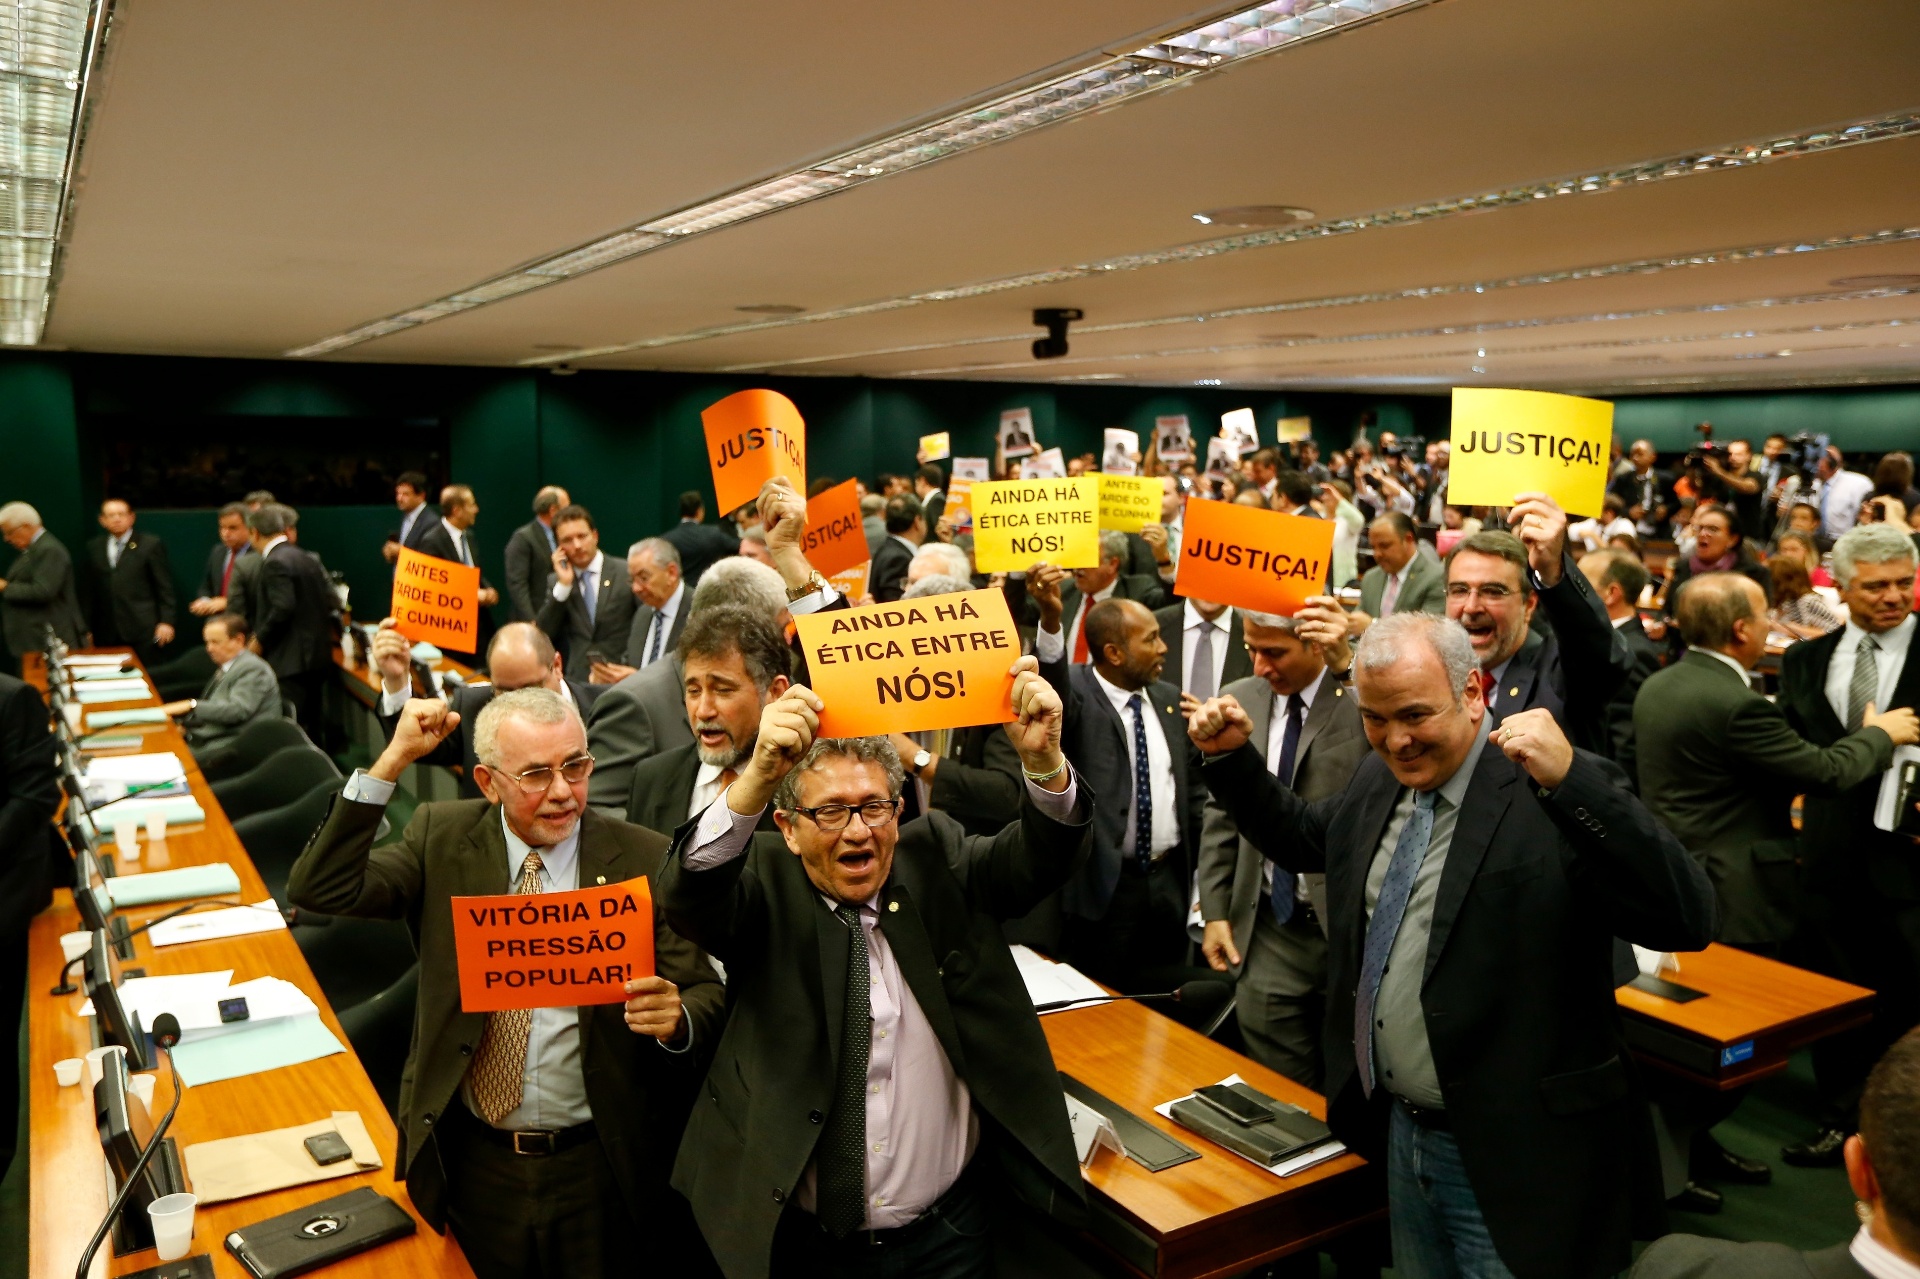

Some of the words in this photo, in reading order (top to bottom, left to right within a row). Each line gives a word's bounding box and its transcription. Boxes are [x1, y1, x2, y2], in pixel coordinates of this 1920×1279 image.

[1460, 430, 1601, 467] JUSTIÇA!
[990, 488, 1048, 505] AINDA
[1055, 483, 1080, 501] HÁ
[1105, 480, 1140, 490] ANTES
[1098, 493, 1130, 504] ARDE
[1133, 496, 1150, 506] DO
[980, 512, 1030, 529] ÉTICA
[1036, 510, 1093, 526] ENTRE
[1011, 532, 1064, 554] NÓS!
[405, 560, 448, 584] ANTES
[1188, 538, 1319, 581] JUSTIÇA!
[438, 594, 463, 610] DO
[407, 610, 468, 633] CUNHA!
[831, 608, 928, 635] AINDA
[934, 598, 979, 622] HÁ
[817, 640, 904, 665] ÉTICA
[911, 630, 1009, 656] ENTRE
[876, 666, 966, 705] NÓS!
[469, 901, 590, 927] VITÓRIA
[600, 894, 638, 918] DA
[487, 929, 626, 958] PRESSÃO
[485, 963, 632, 989] POPULAR!
